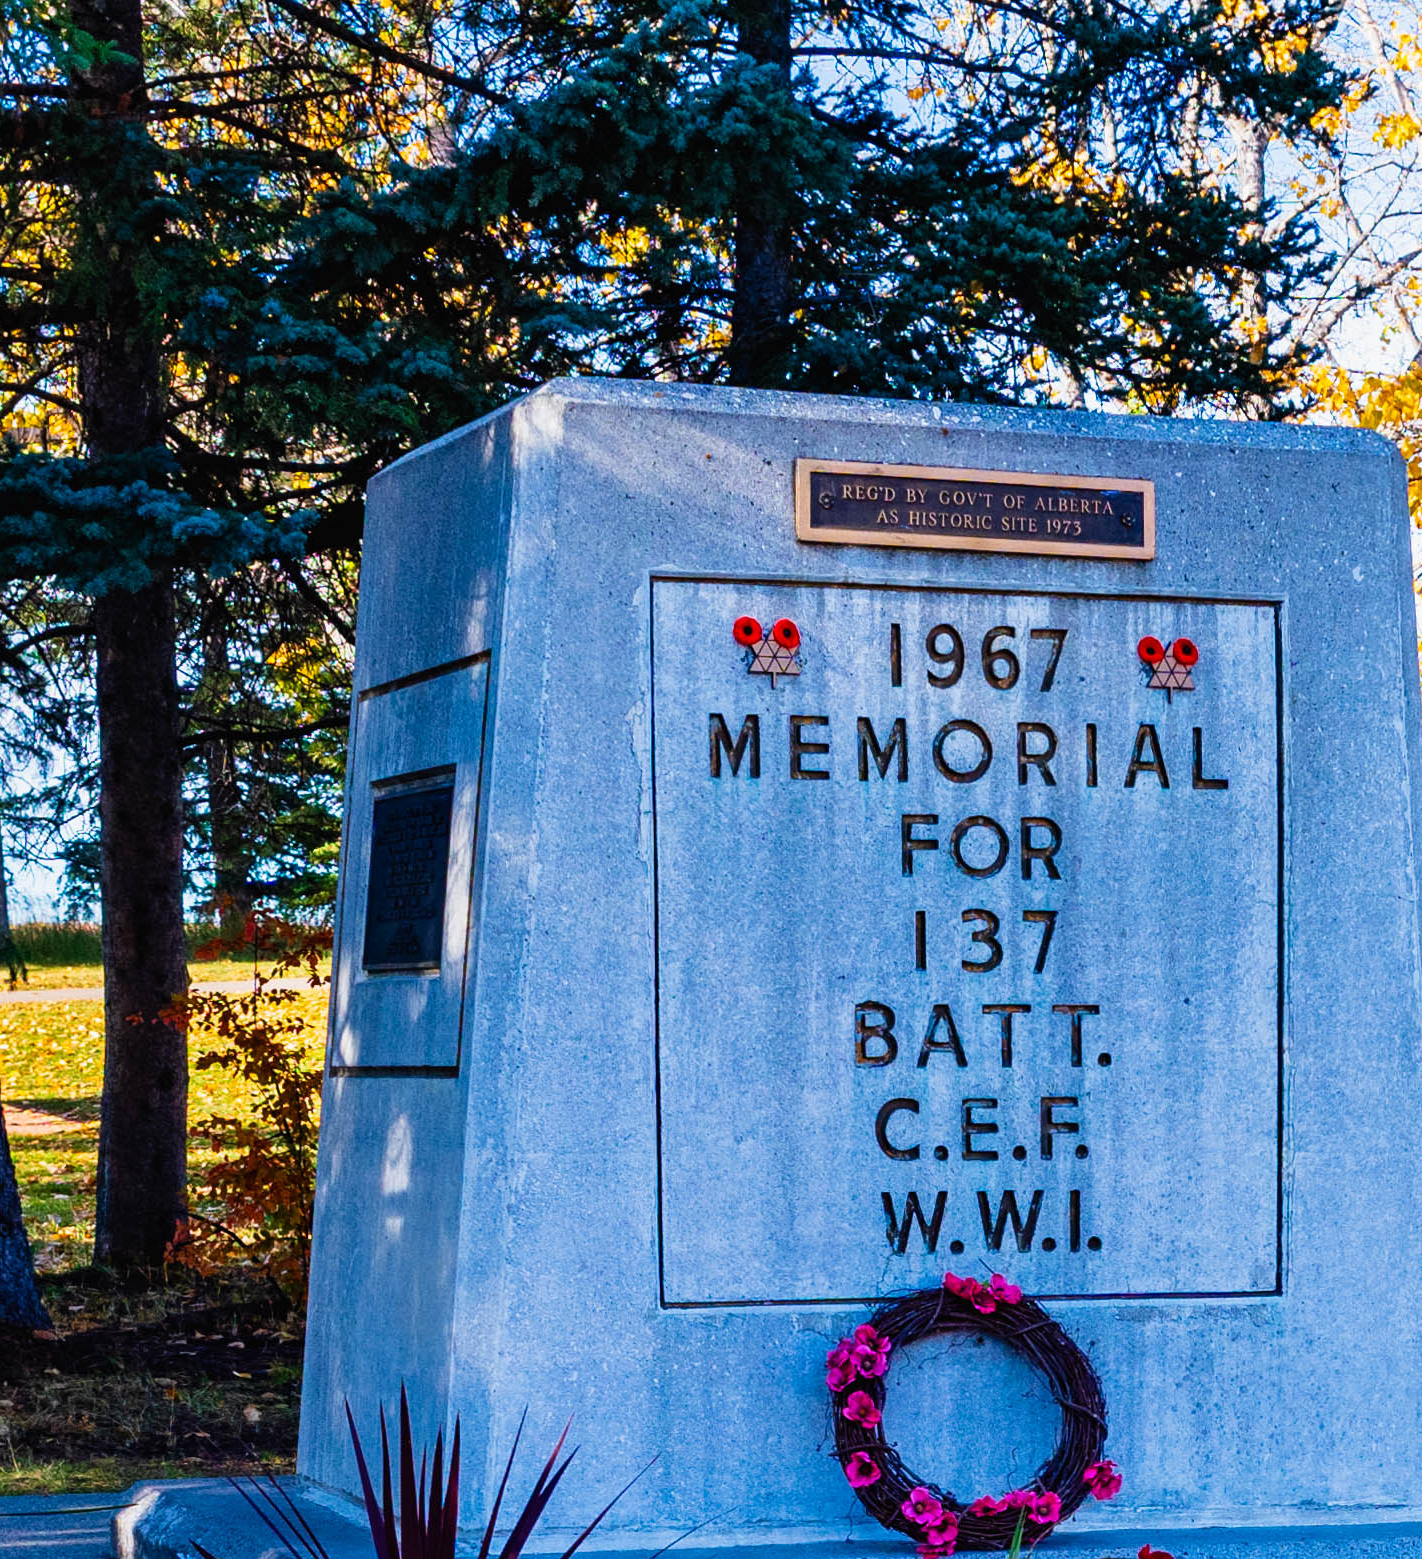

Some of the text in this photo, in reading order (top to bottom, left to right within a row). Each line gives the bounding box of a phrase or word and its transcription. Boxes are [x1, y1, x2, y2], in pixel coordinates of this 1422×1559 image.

[842, 484, 1115, 516] REG'D BY GOV'T OF ALBERTA
[876, 510, 899, 525] AS
[909, 511, 992, 530] HISTORIC
[1001, 518, 1037, 532] SITE
[890, 622, 1069, 692] 1967
[709, 713, 1229, 789] MEMORIAL
[901, 814, 1063, 880] FOR
[915, 909, 1059, 974] 137
[854, 1001, 1112, 1068] BATT.
[876, 1098, 1089, 1161] C.E.F.
[881, 1189, 1103, 1255] W.W.I.
